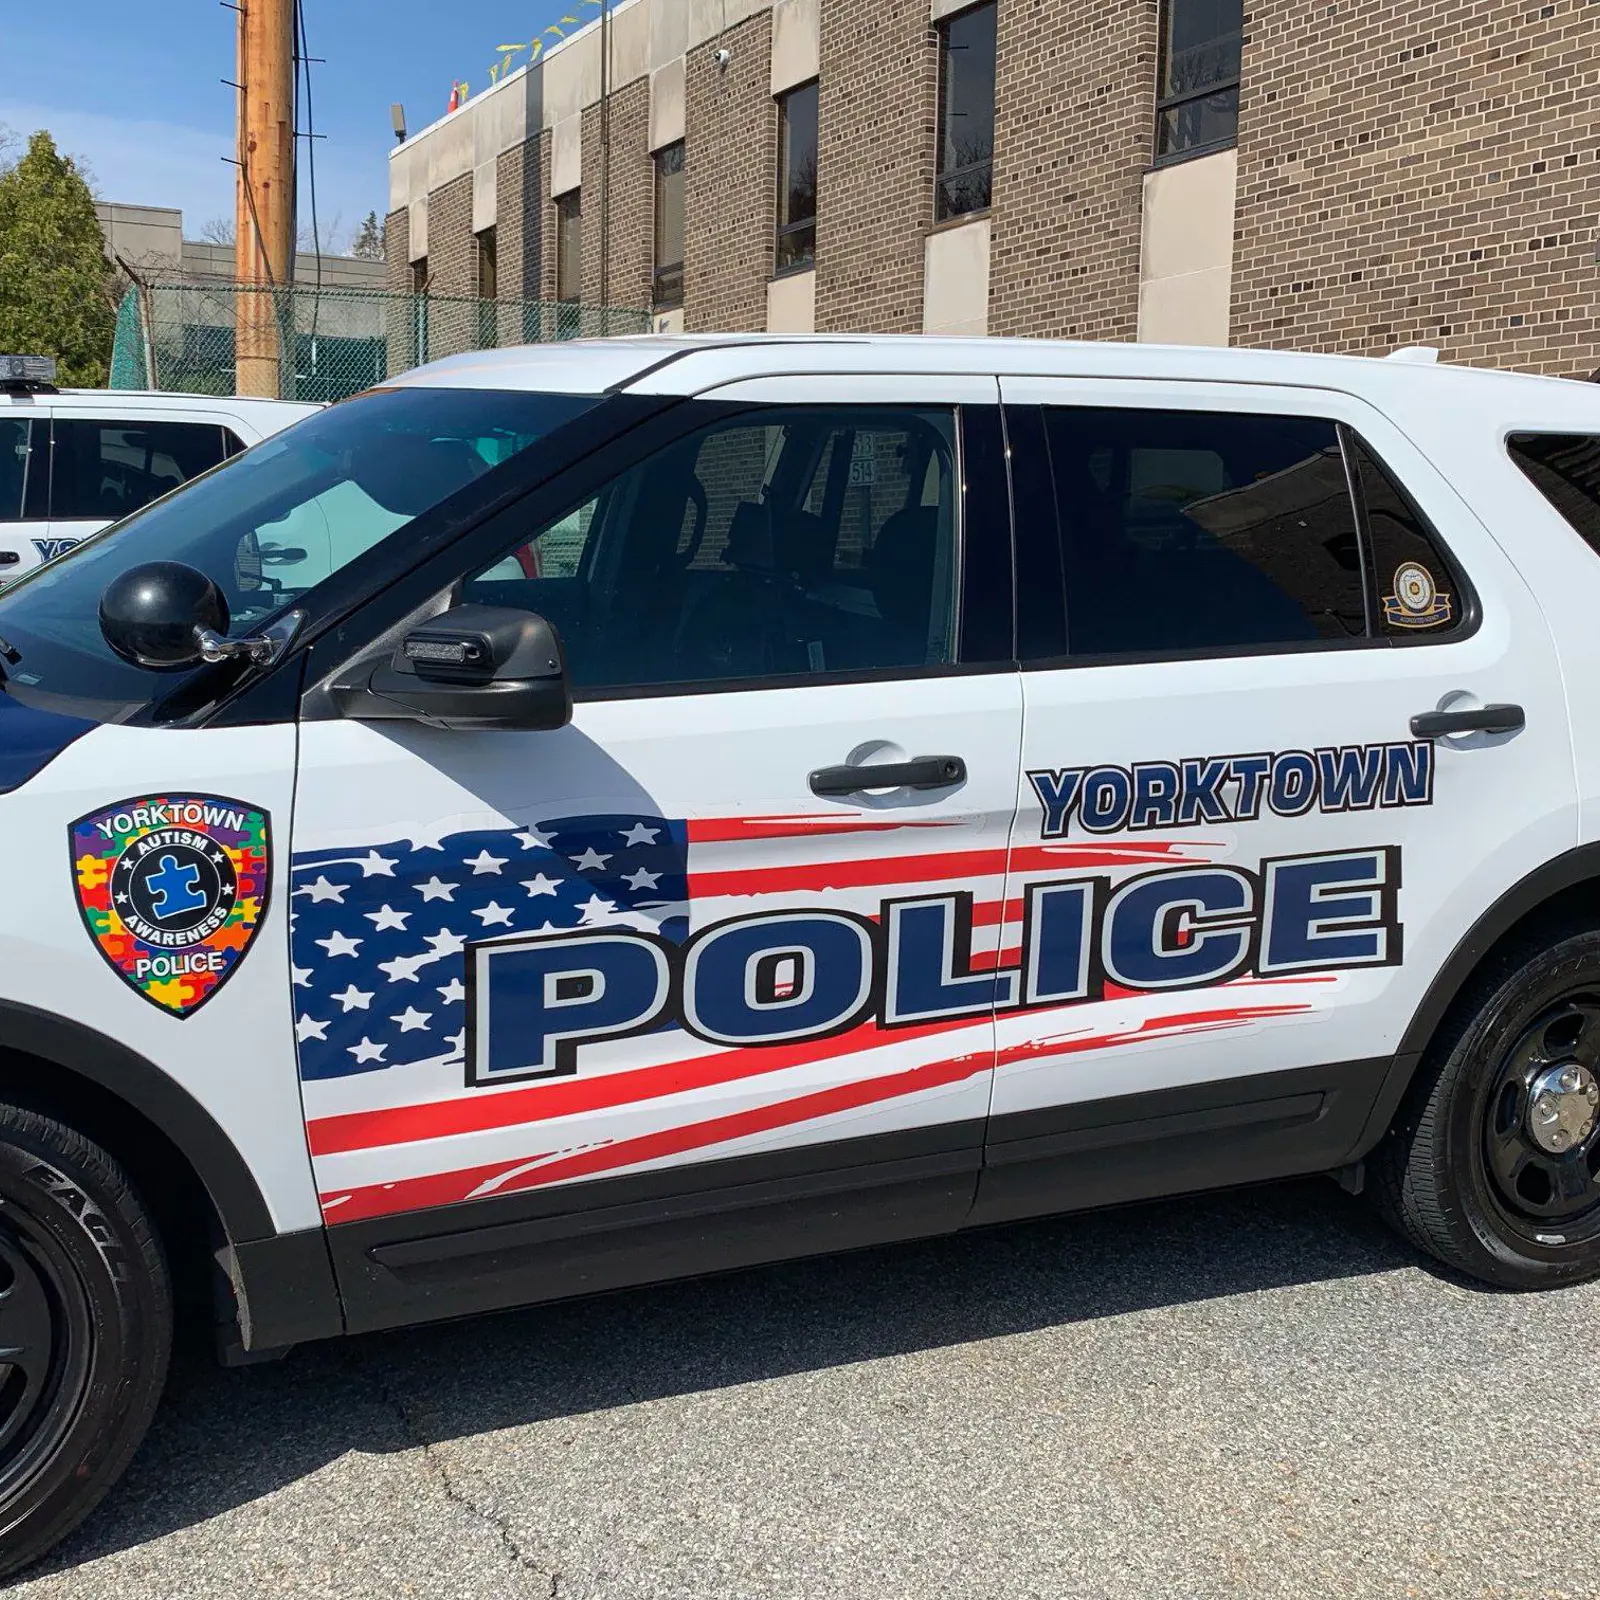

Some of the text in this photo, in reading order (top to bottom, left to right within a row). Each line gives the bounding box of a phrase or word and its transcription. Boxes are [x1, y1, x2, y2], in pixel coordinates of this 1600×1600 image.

[852, 462, 872, 481] 514
[1025, 740, 1435, 839] YORKTOWN
[96, 803, 244, 839] YORKTOWN
[138, 831, 208, 855] AUTISM
[124, 906, 228, 946] AWARENESS
[136, 951, 224, 978] POLICE
[464, 844, 1403, 1087] POLICE
[22, 1162, 129, 1298] EAGL
